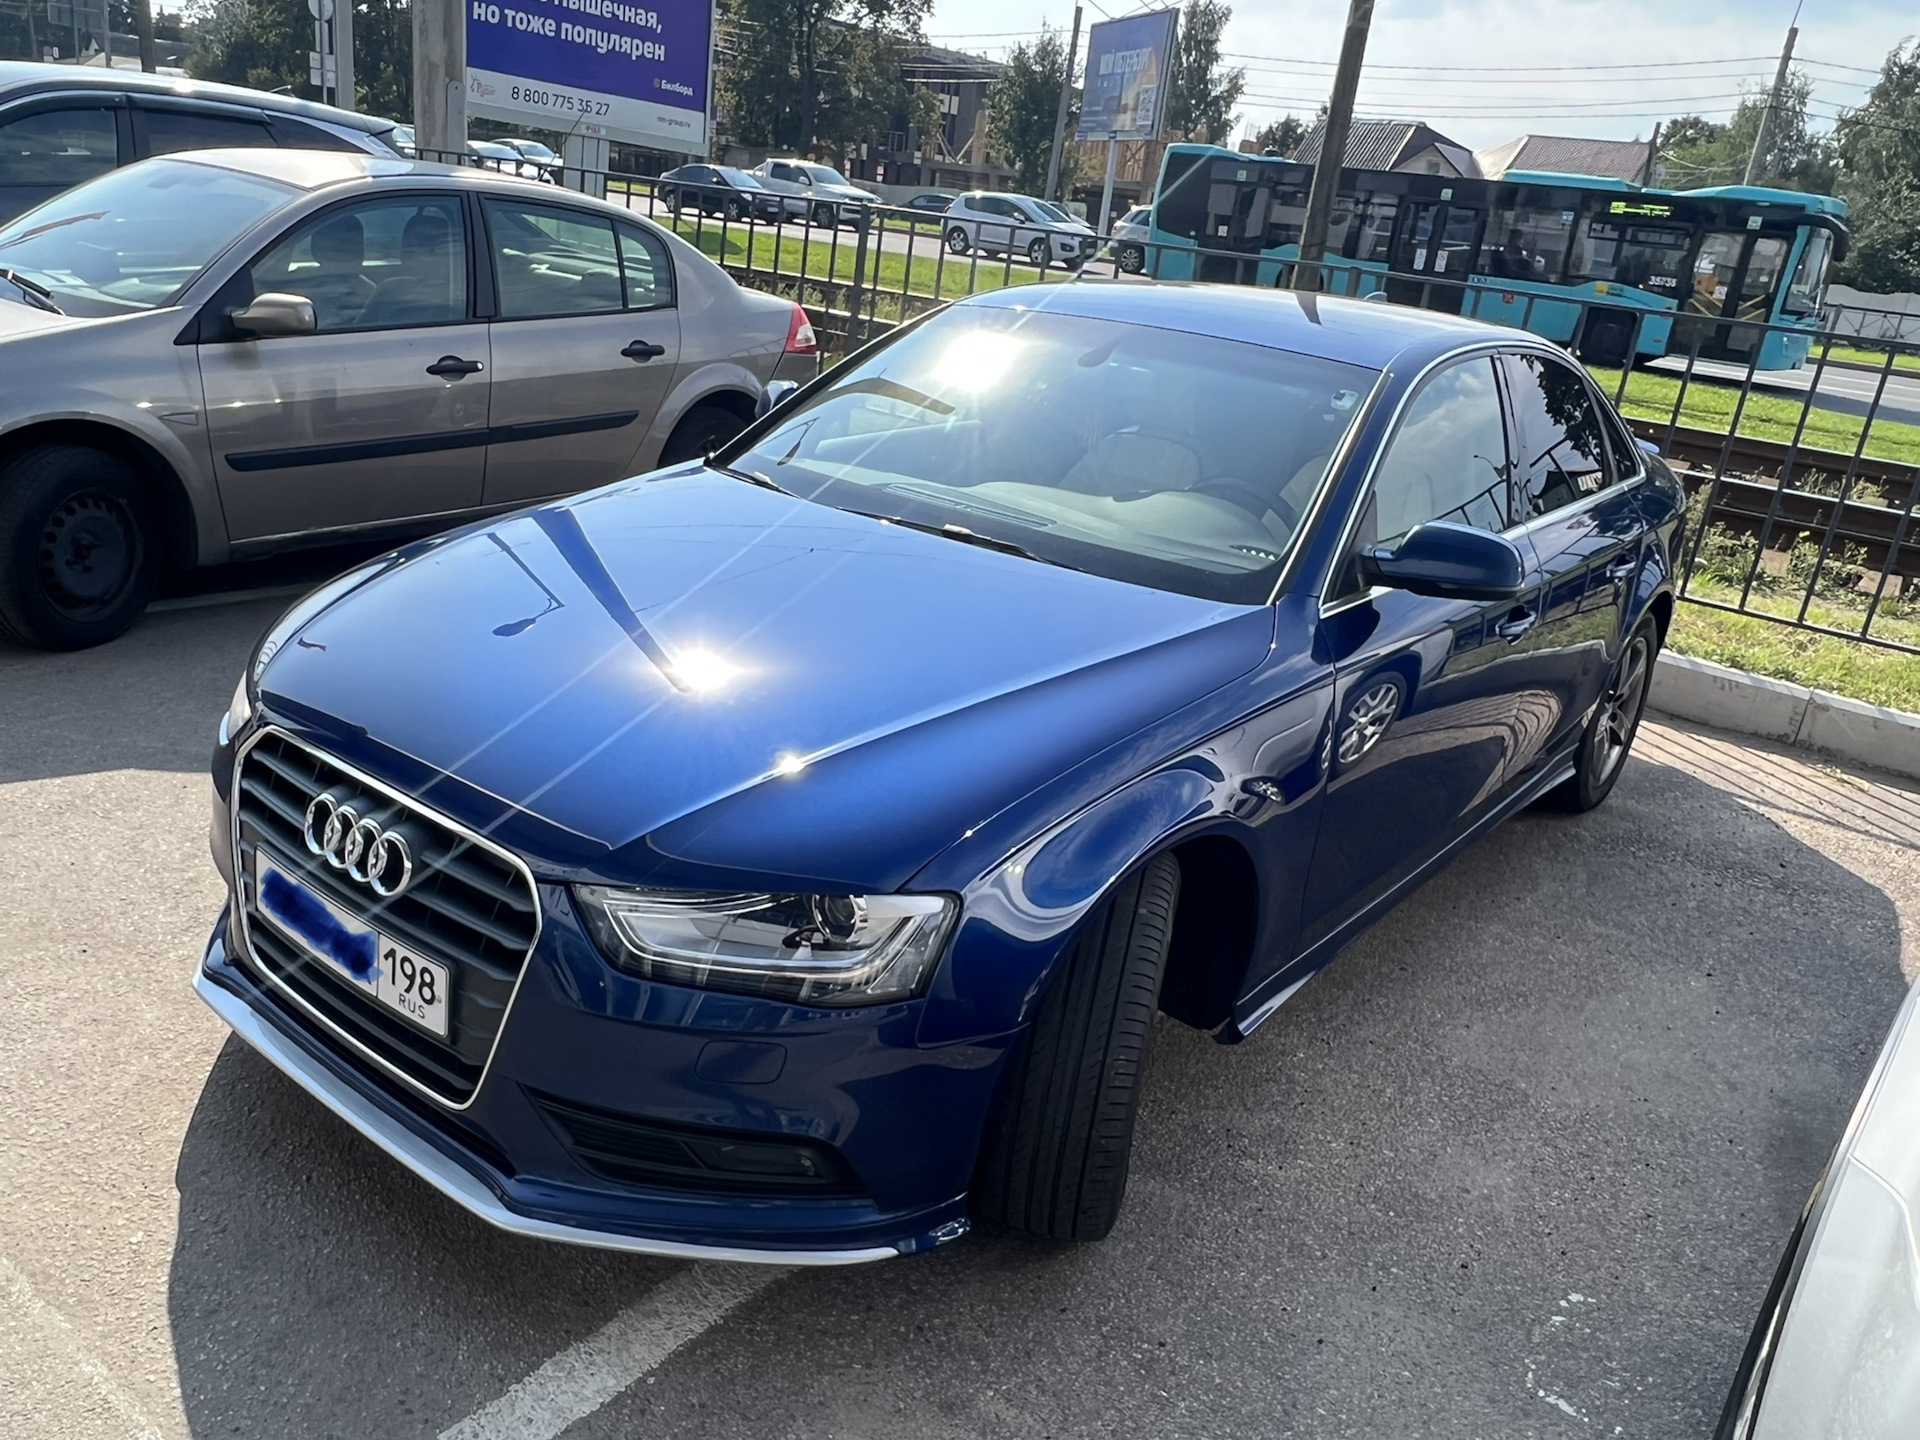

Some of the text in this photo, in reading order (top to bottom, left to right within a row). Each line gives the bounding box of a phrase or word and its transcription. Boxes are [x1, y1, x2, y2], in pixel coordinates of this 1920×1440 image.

[473, 1, 665, 61] но тоже популярен
[511, 86, 520, 101] 8
[523, 88, 549, 106] 800
[552, 93, 574, 110] 775
[595, 102, 610, 116] 27
[383, 947, 436, 1006] 198
[398, 992, 426, 1019] RUS
